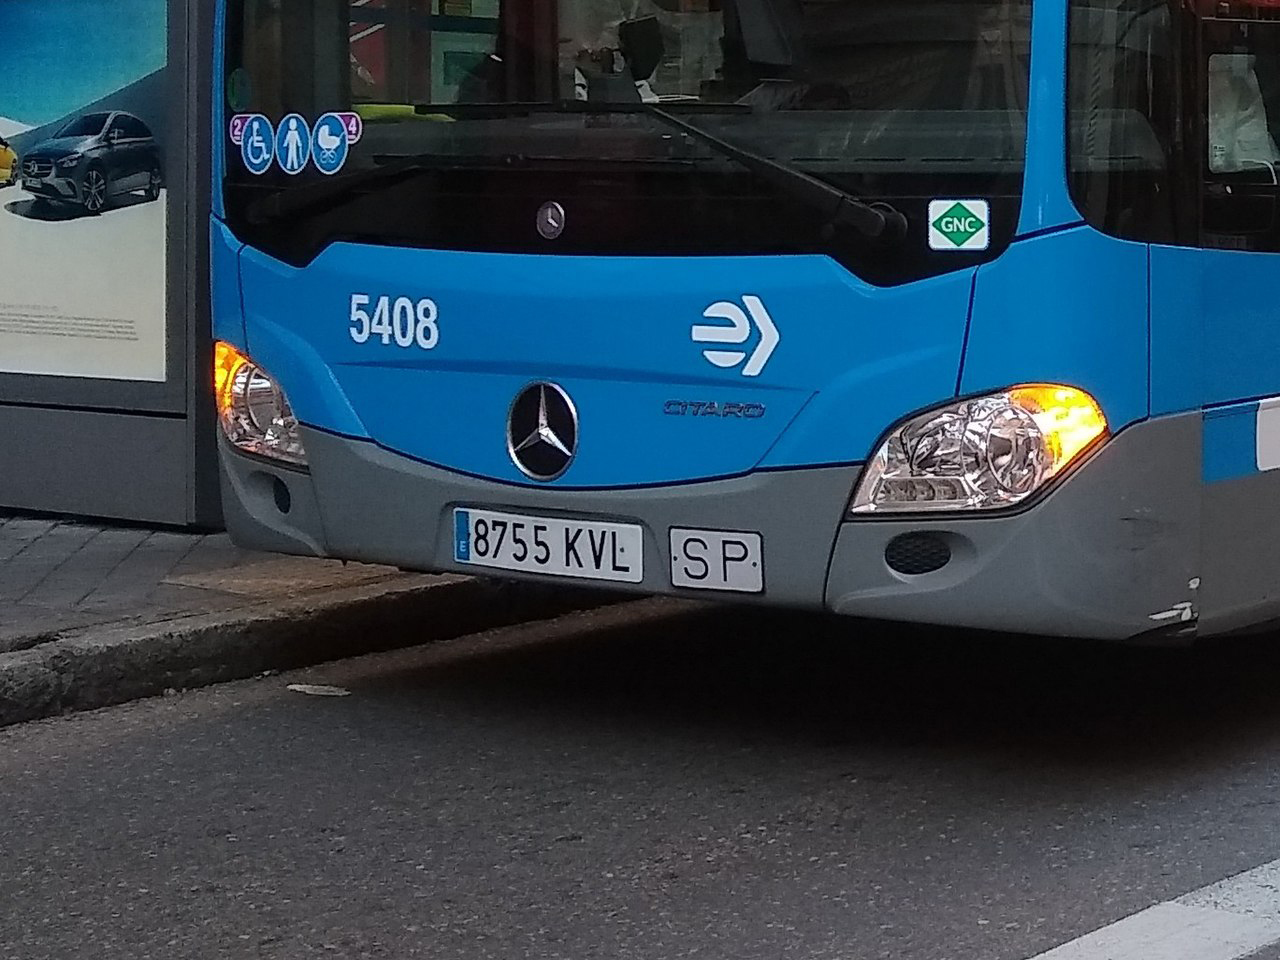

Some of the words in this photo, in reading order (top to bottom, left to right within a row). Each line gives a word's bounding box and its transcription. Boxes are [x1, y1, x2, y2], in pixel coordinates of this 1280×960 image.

[233, 119, 242, 136] 2
[348, 117, 357, 135] 4
[940, 217, 977, 232] GNC
[349, 293, 439, 350] 5408
[663, 399, 766, 418] CITARO
[459, 540, 467, 551] E
[473, 518, 551, 566] 8755
[564, 526, 630, 573] KVL
